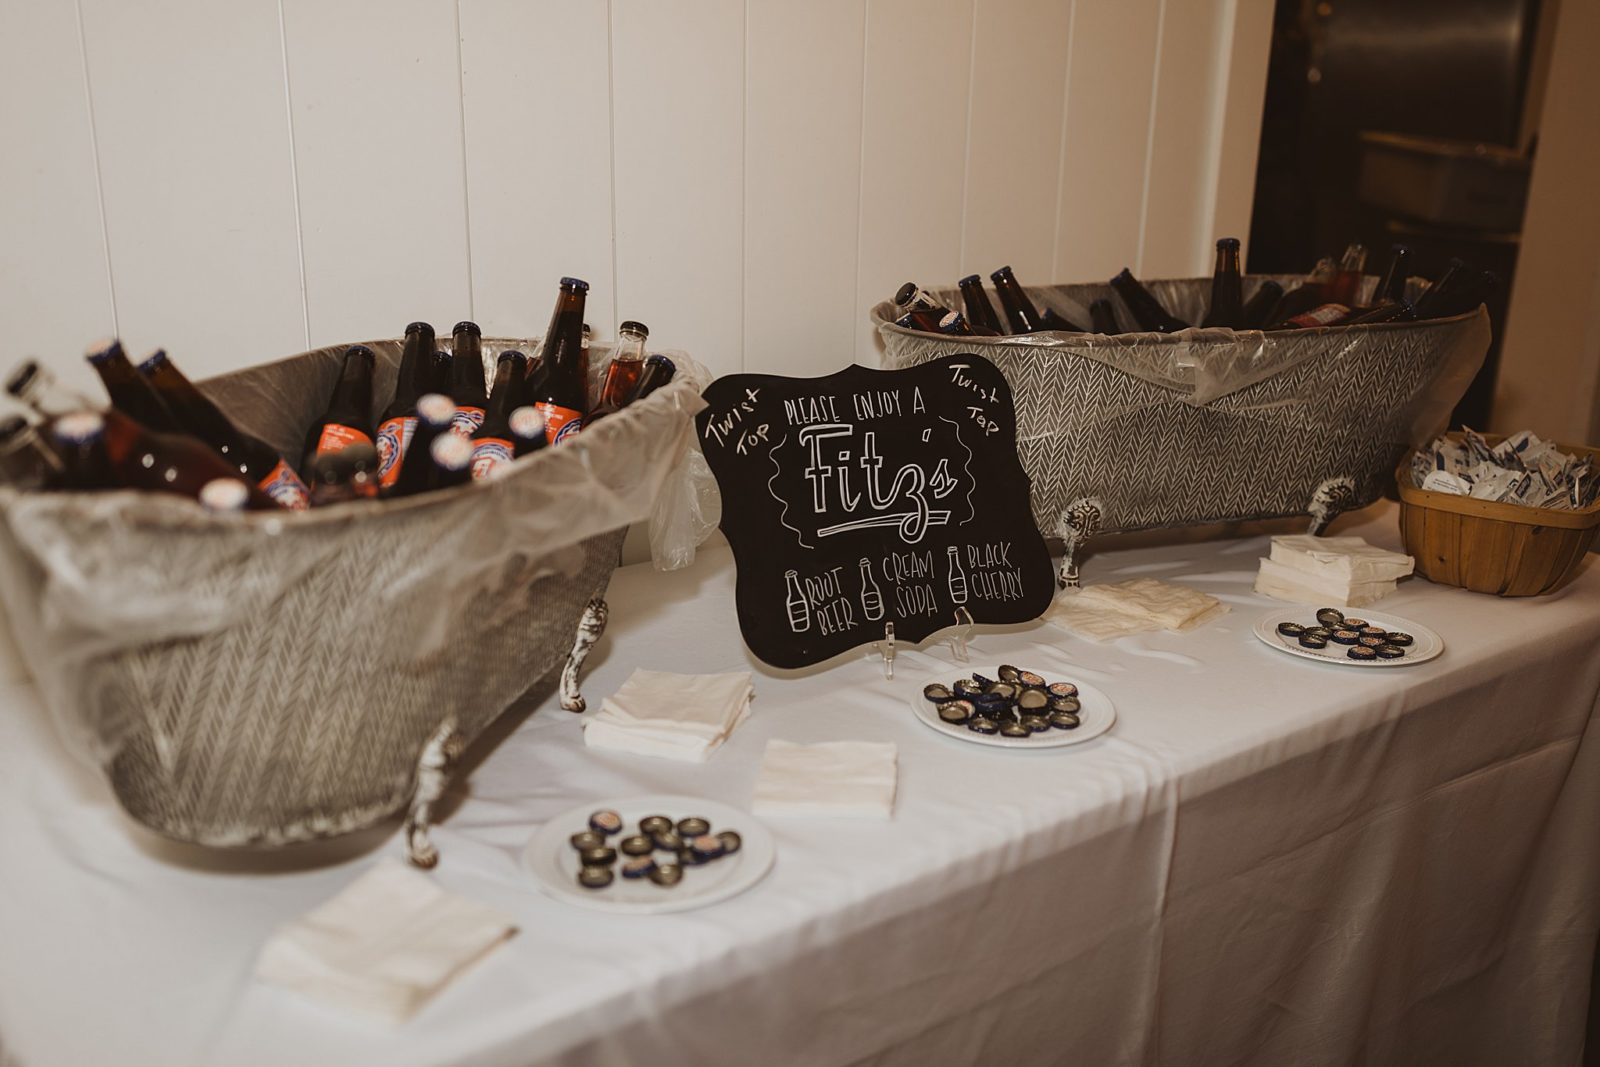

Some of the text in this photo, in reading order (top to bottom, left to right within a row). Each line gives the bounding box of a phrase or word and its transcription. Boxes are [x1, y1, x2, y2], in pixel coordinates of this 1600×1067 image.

[784, 386, 926, 426] PLEASE ENJOY A
[882, 550, 935, 585] CREAM
[966, 541, 1013, 569] BLACK
[805, 566, 843, 610] ROOT
[896, 584, 938, 619] SODA
[971, 567, 1024, 602] CHERRY
[816, 597, 859, 636] BEER
